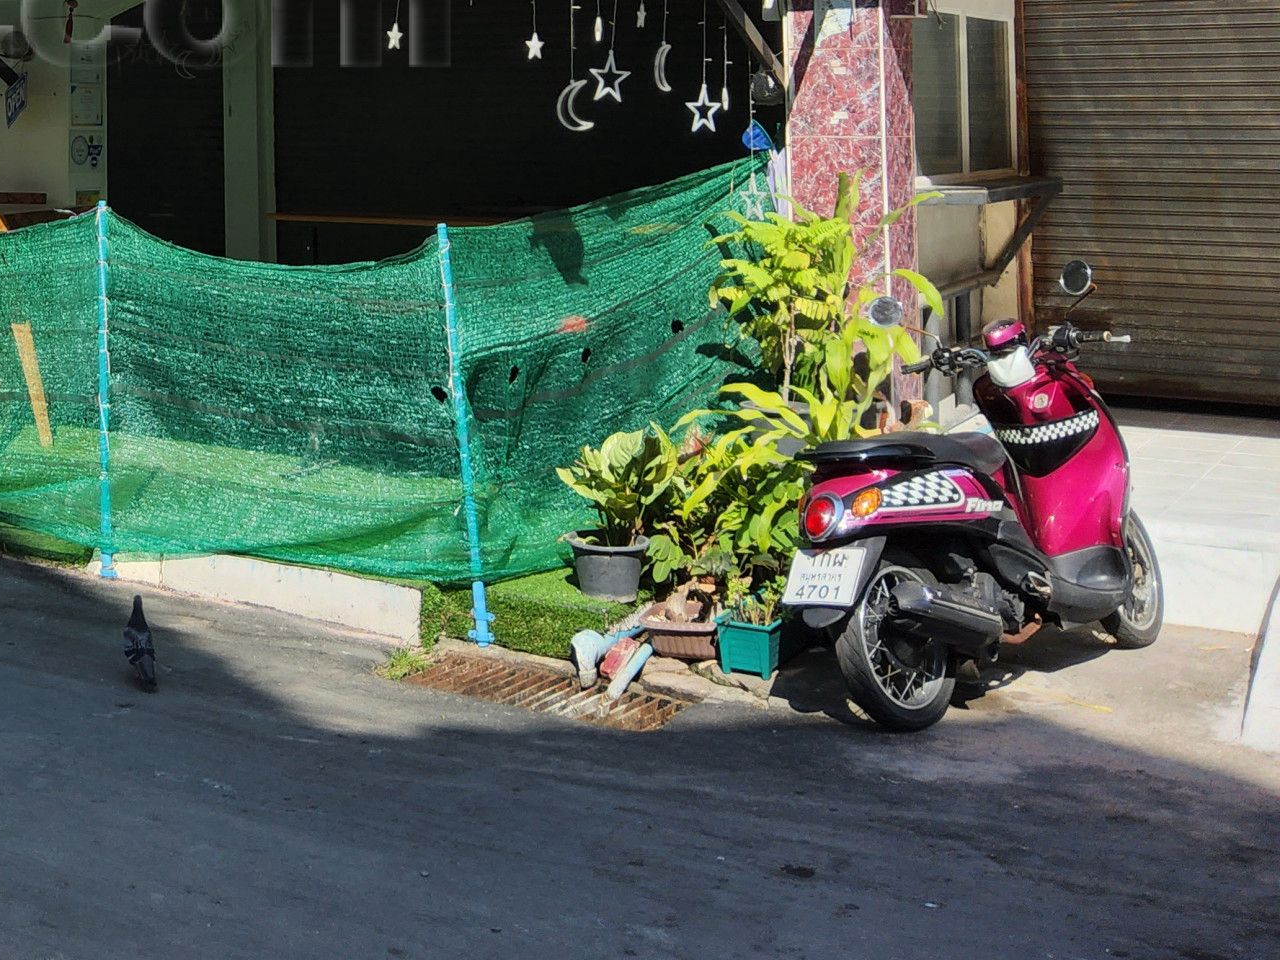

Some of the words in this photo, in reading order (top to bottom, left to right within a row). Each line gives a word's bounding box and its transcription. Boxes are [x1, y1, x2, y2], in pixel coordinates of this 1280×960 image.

[6, 83, 25, 117] OPEN
[965, 497, 1004, 513] Fino
[795, 585, 841, 600] 4701
